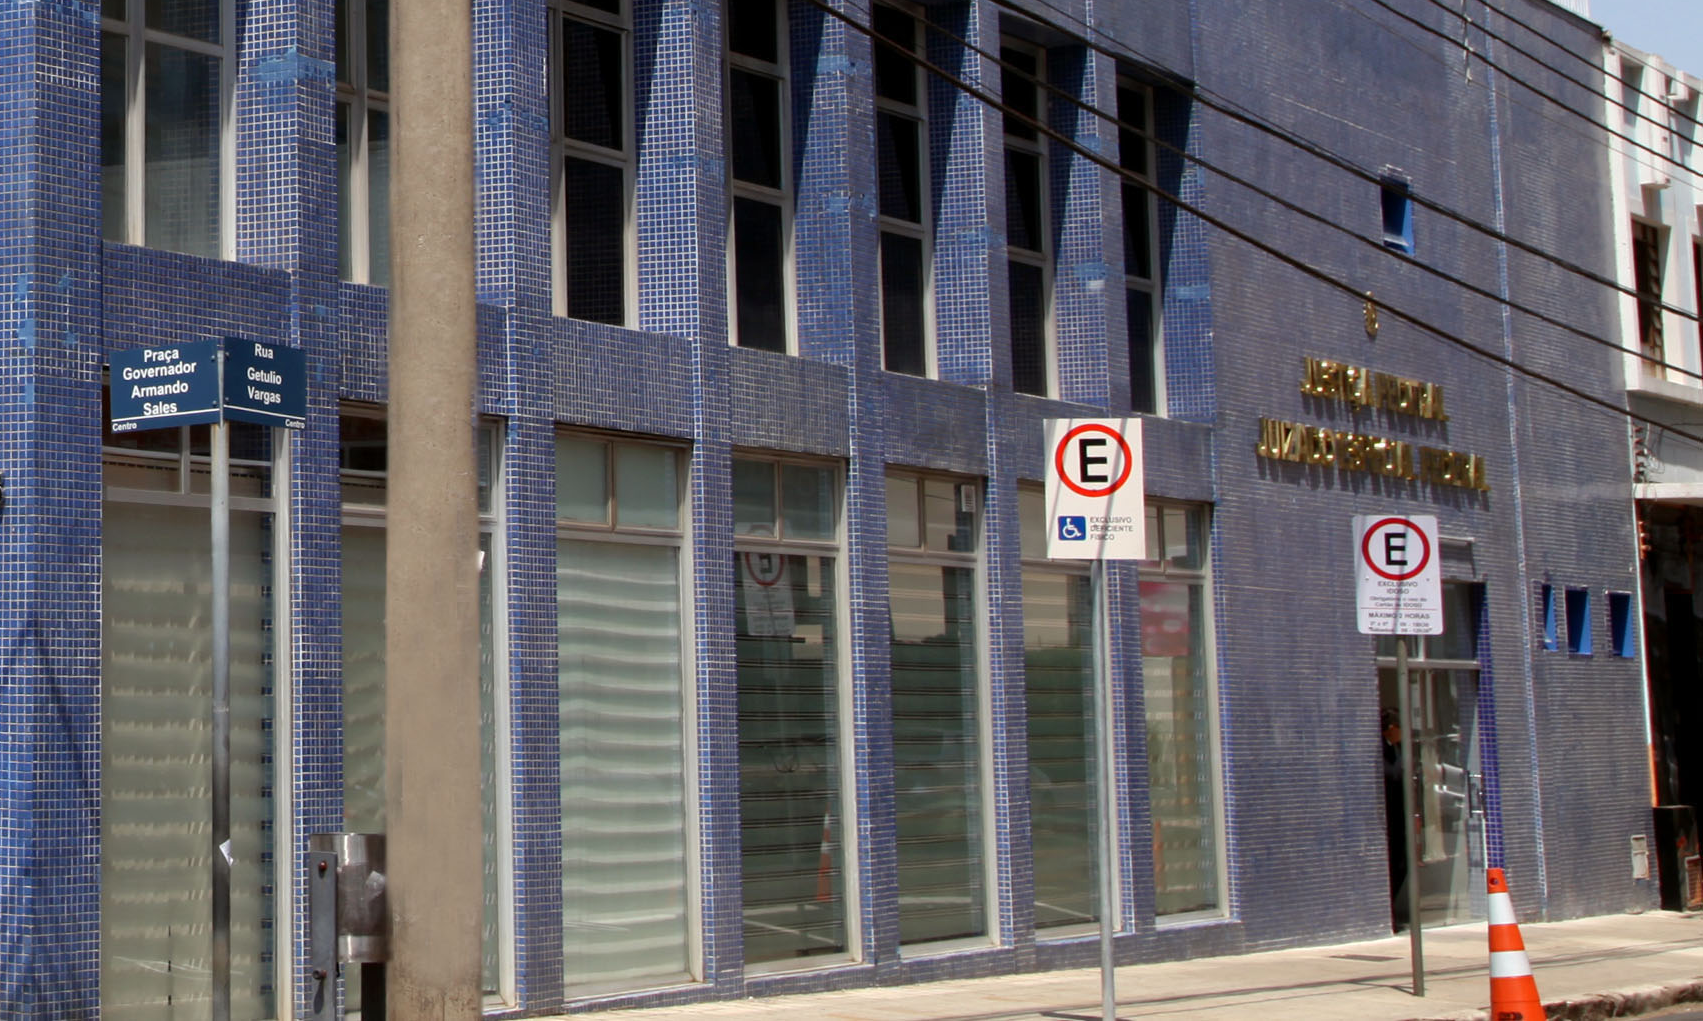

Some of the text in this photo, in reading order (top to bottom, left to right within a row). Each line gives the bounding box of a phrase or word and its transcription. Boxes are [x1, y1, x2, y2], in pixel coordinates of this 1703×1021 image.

[143, 348, 179, 364] Praça
[254, 343, 274, 360] Rua
[123, 361, 197, 381] Governador
[247, 367, 282, 385] Getulio
[131, 380, 189, 399] Armando
[247, 386, 282, 405] Vargas
[143, 402, 178, 416] Sales
[112, 421, 137, 432] Centro
[285, 419, 306, 429] Centro
[1079, 438, 1109, 483] E
[1384, 532, 1408, 566] E
